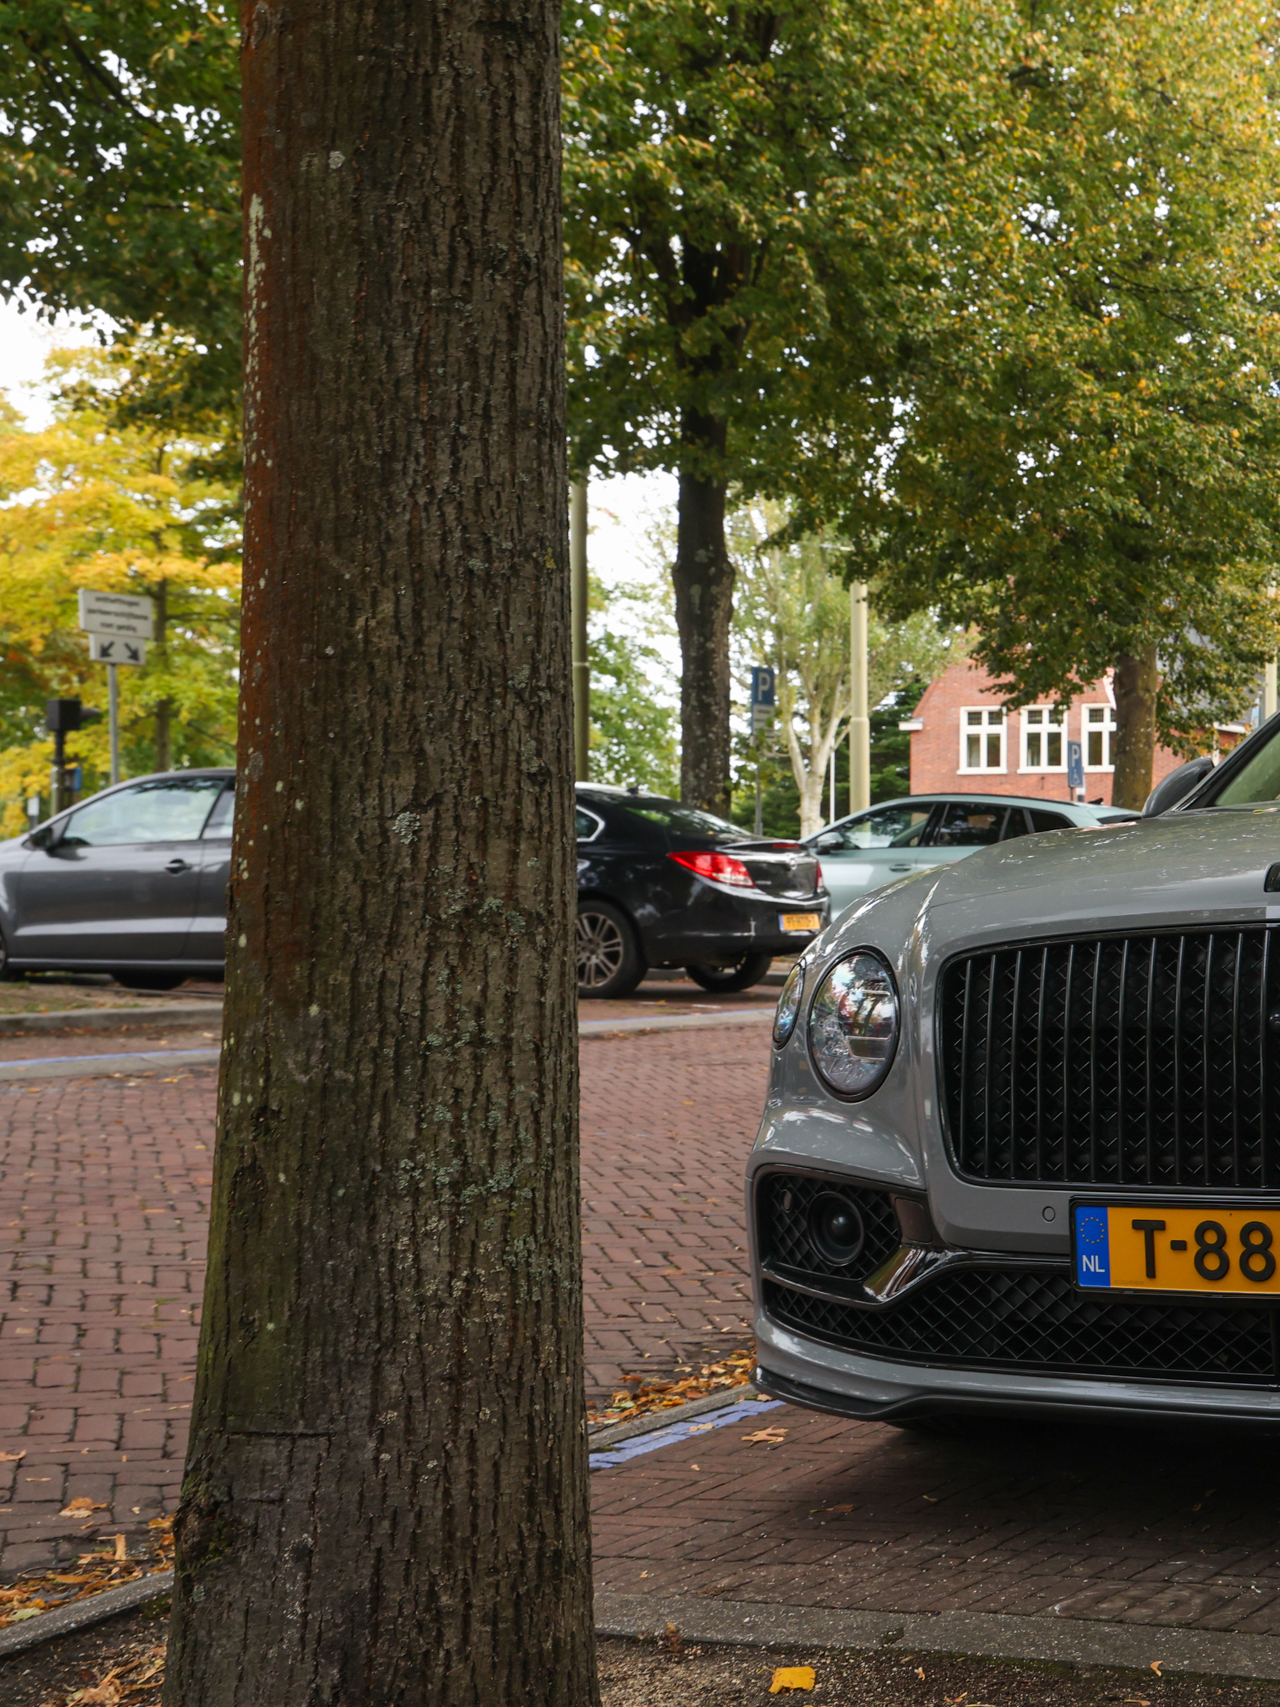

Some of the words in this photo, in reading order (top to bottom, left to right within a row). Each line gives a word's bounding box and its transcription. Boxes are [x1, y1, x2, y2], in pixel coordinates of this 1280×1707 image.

[757, 671, 771, 701] P
[1071, 744, 1080, 767] P
[1082, 1254, 1106, 1273] NL
